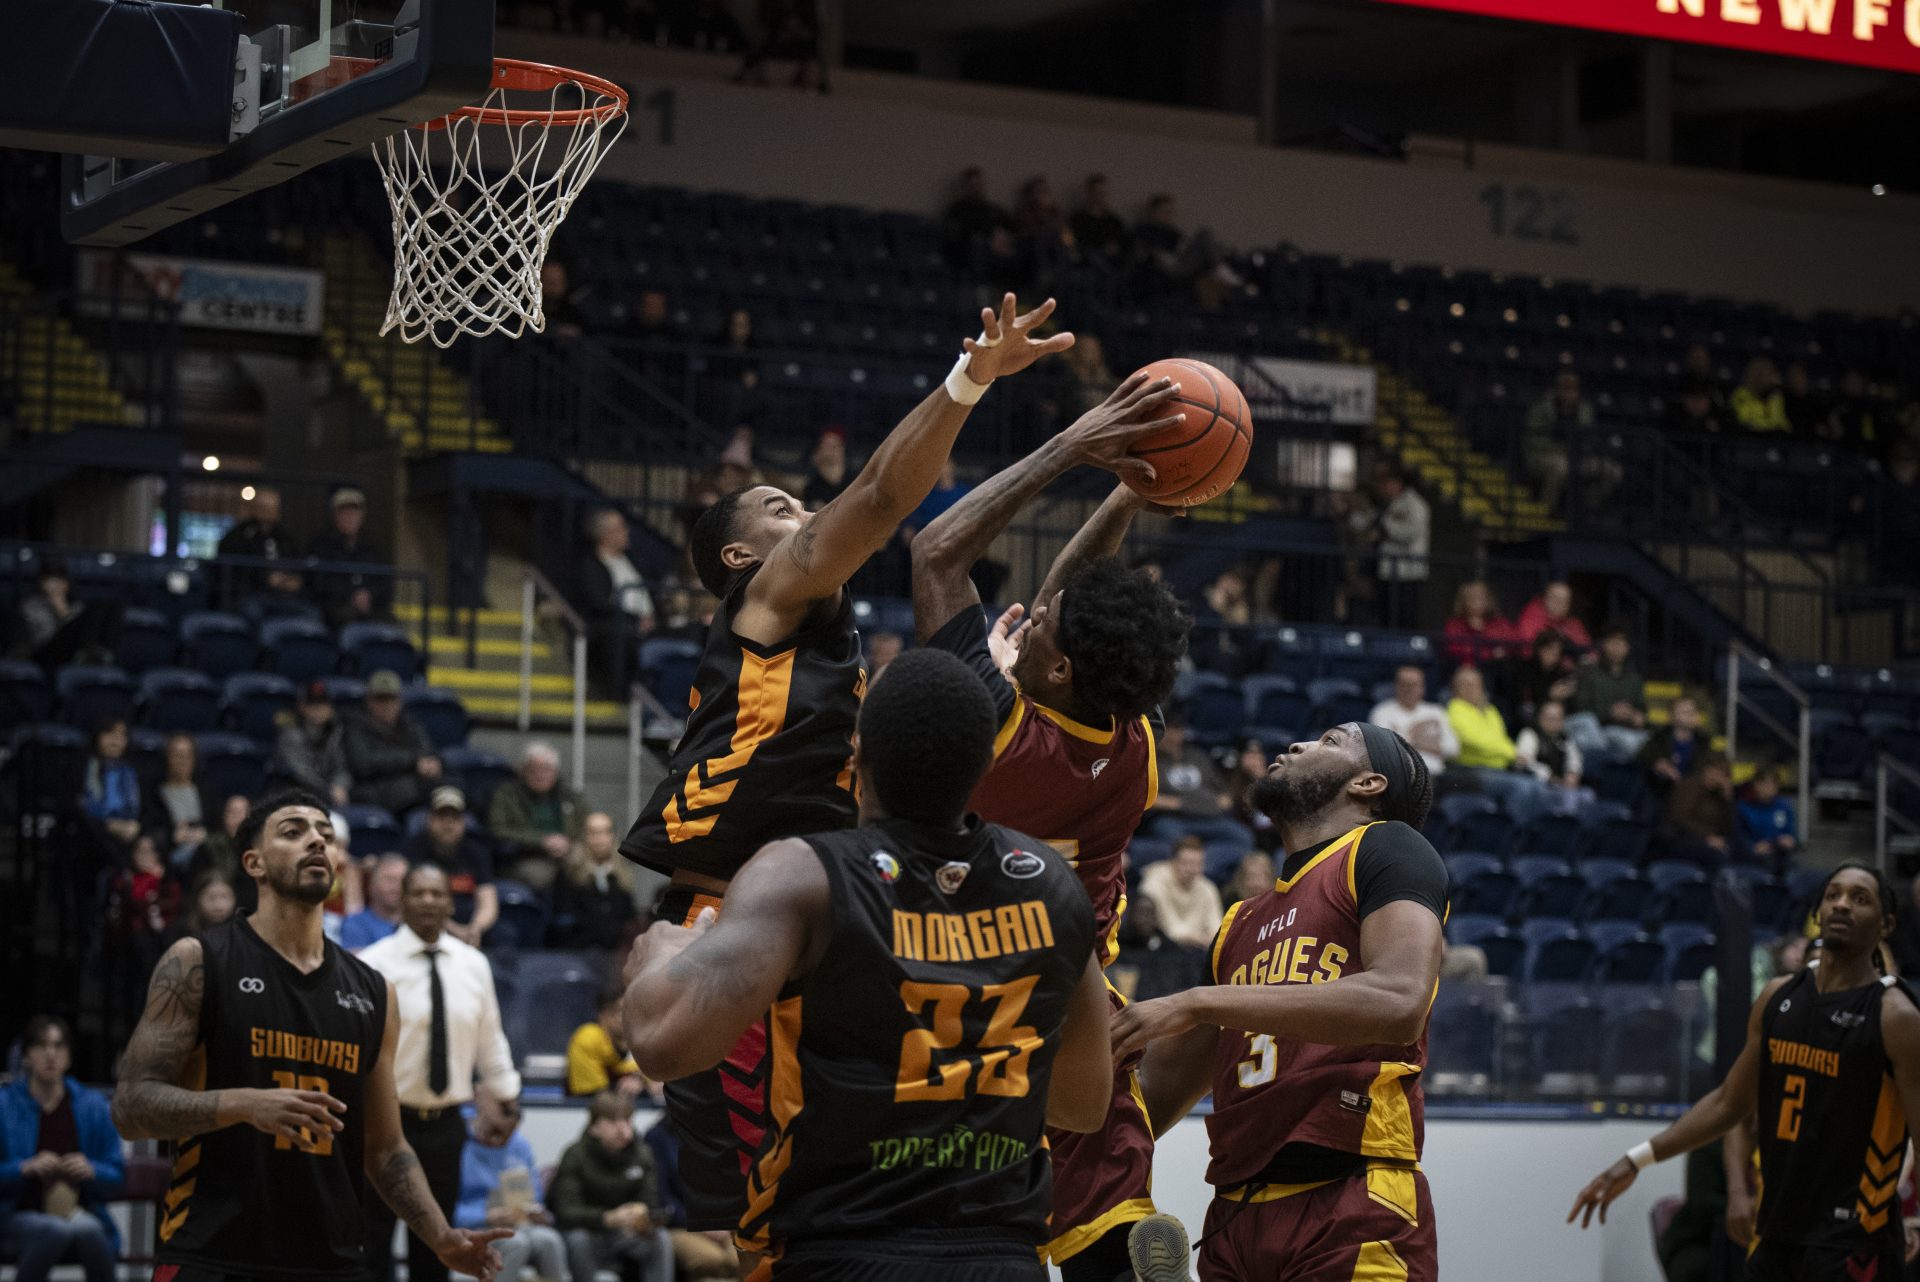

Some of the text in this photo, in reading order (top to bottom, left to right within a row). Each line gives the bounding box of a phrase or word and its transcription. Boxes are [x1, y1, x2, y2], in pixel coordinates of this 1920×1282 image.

[1480, 183, 1580, 245] 122
[892, 900, 1055, 962] MORGAN
[1257, 907, 1297, 943] NFLD
[251, 1026, 361, 1075] SUDBURY
[894, 973, 1045, 1103] 23
[1237, 1031, 1278, 1089] 3
[1776, 1073, 1807, 1142] 2
